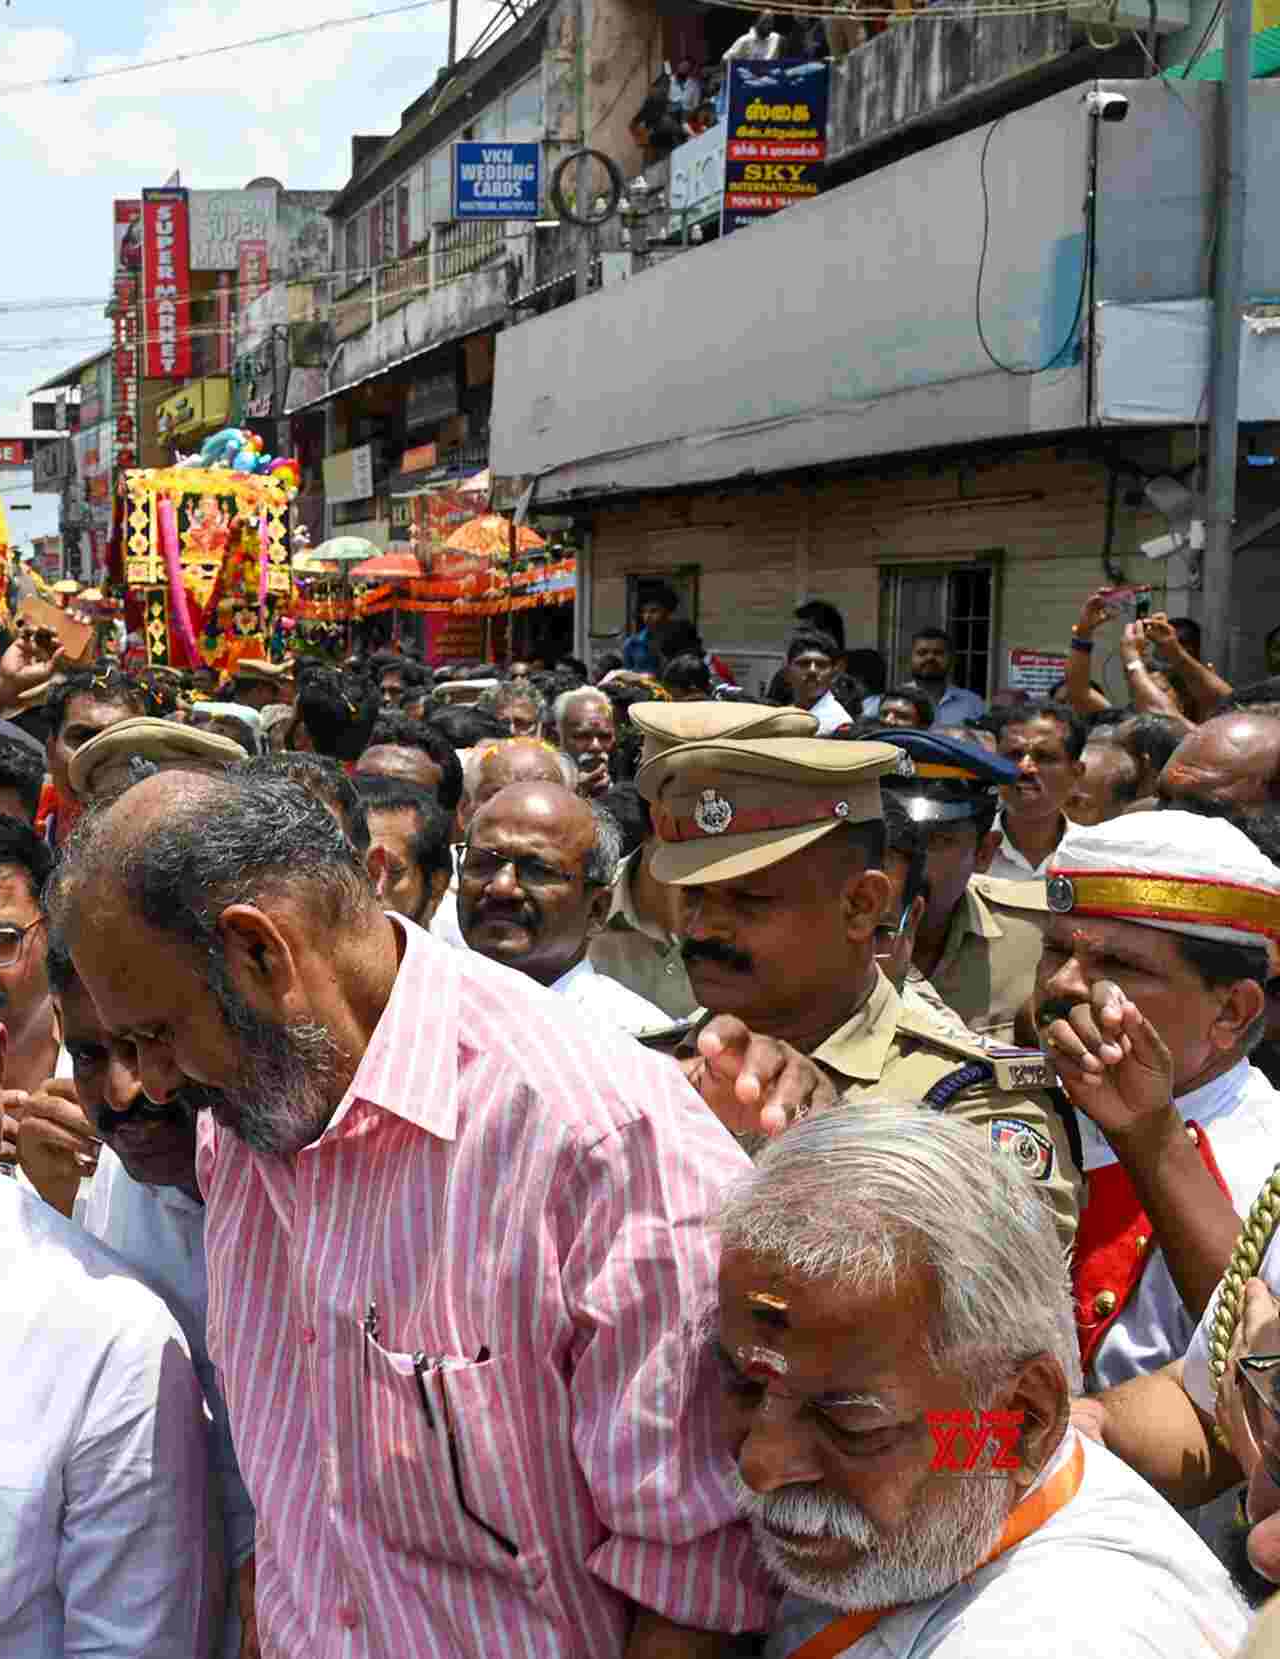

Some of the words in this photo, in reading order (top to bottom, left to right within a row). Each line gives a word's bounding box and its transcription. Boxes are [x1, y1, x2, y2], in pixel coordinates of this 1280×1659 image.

[460, 163, 535, 181] WEDDING
[743, 164, 808, 181] SKY
[472, 181, 523, 198] CARDS
[155, 206, 175, 280] SUPER
[154, 285, 177, 372] MARKET
